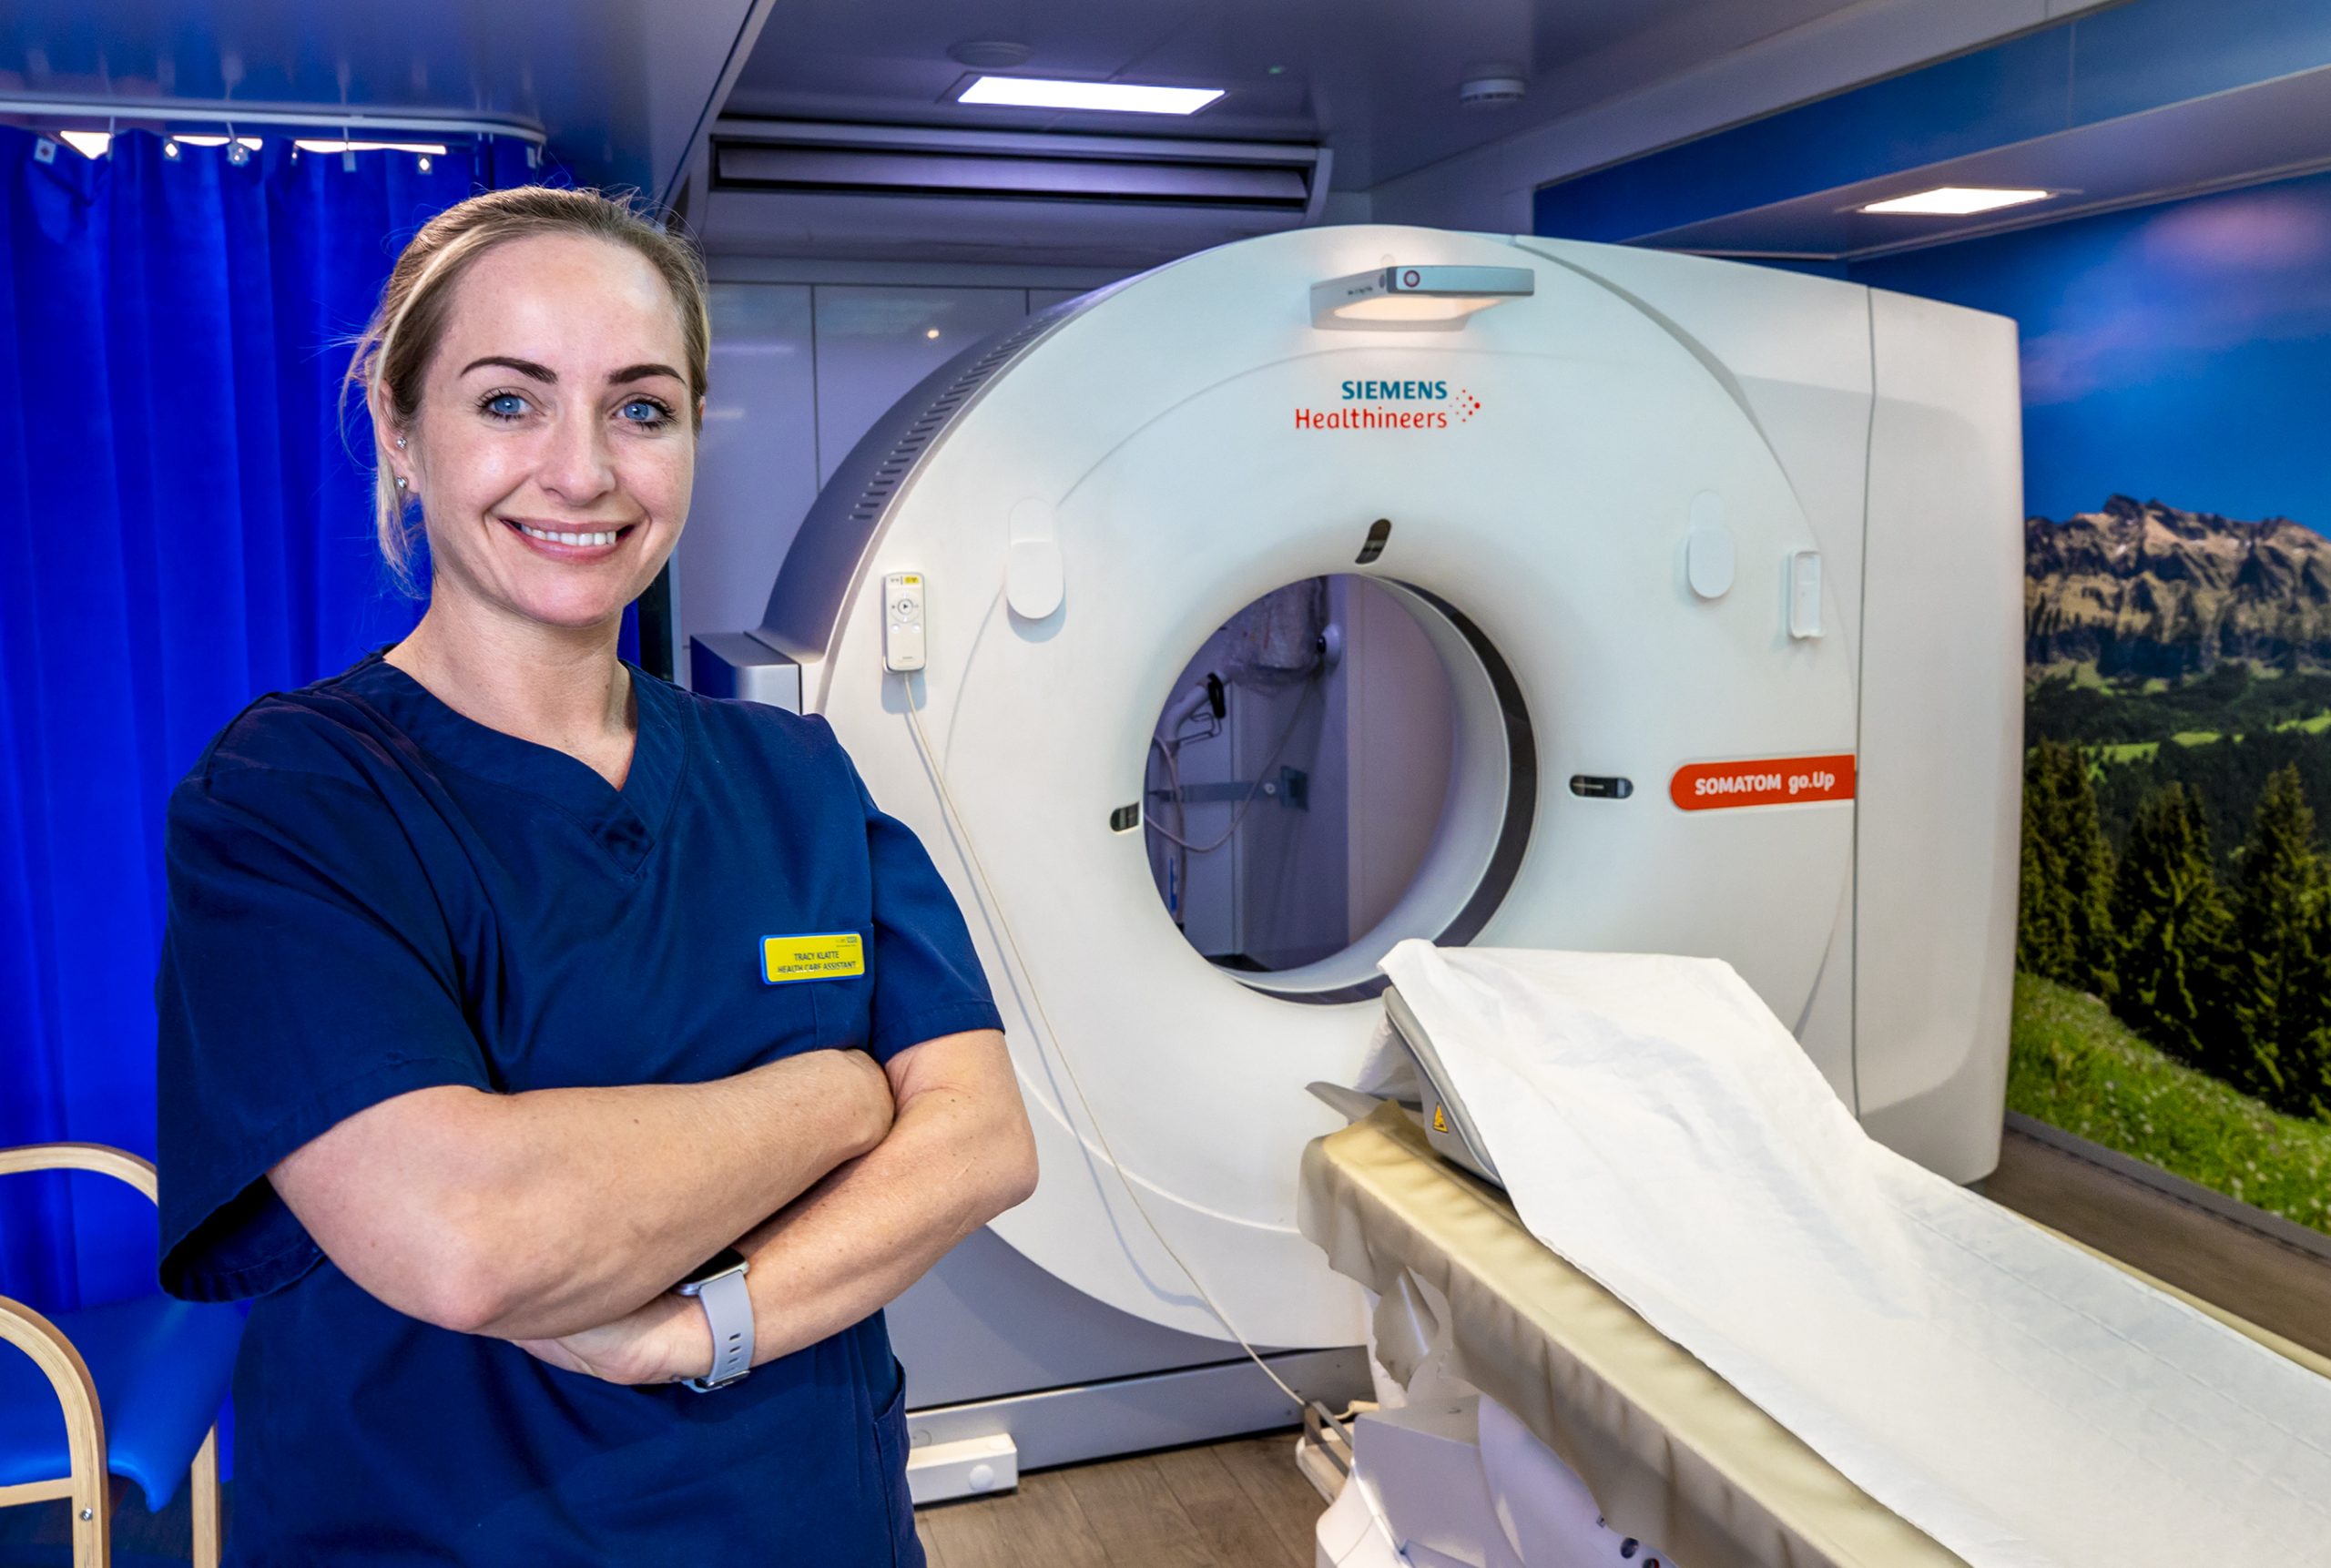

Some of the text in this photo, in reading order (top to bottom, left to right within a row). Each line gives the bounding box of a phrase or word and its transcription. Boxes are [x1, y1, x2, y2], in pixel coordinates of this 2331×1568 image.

[1341, 381, 1448, 400] SIEMENS
[1296, 406, 1448, 429] Healthineers
[1695, 771, 1836, 796] SOMATOM go.Up
[794, 951, 840, 962] TRACY KLATTE
[778, 961, 856, 973] HEALTH CARE ASSISTANT
